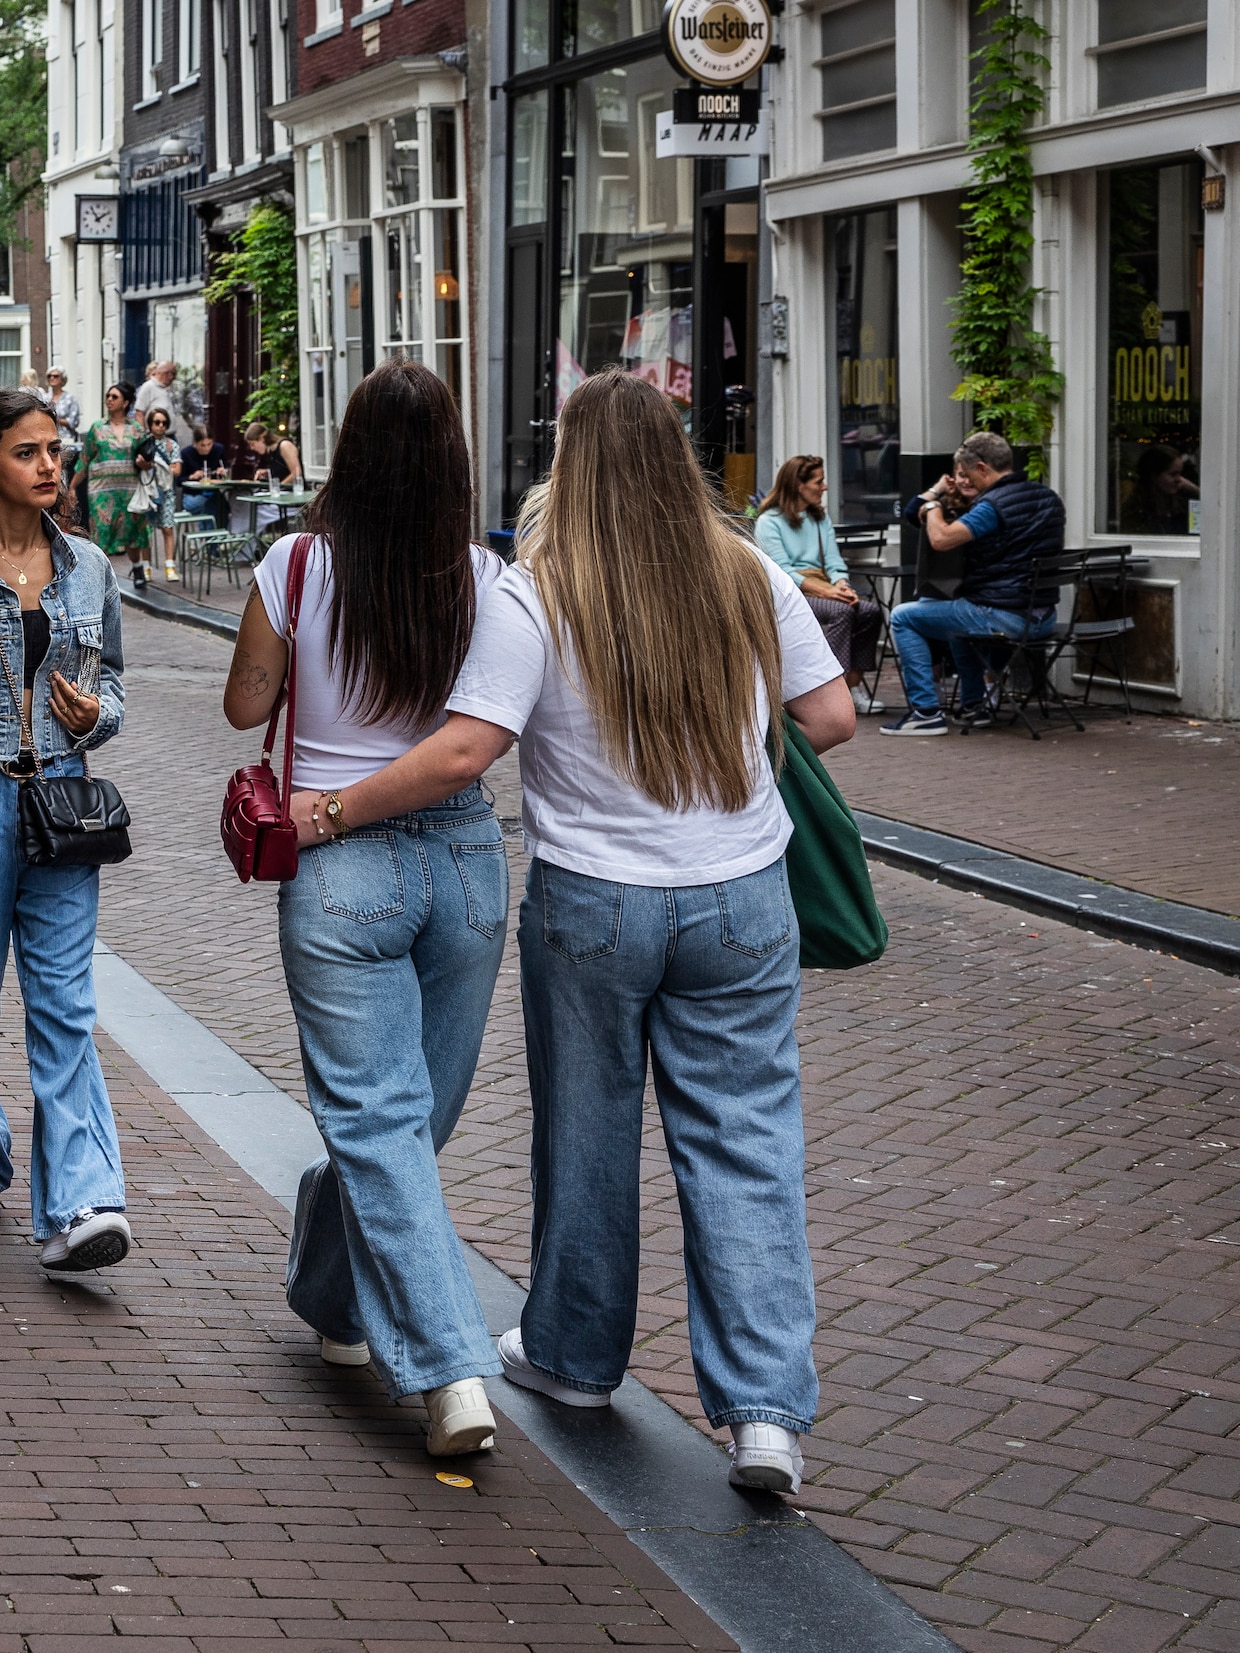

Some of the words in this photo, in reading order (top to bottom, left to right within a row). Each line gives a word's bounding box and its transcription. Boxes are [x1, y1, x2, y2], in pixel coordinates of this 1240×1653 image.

[680, 13, 764, 43] Warsteiner
[698, 95, 740, 113] NOOCH
[697, 123, 757, 142] MAAP
[841, 357, 896, 405] NOOCH
[1115, 345, 1189, 402] NOOCH
[1147, 407, 1190, 425] KITCHEN
[746, 1451, 779, 1461] Reebok
